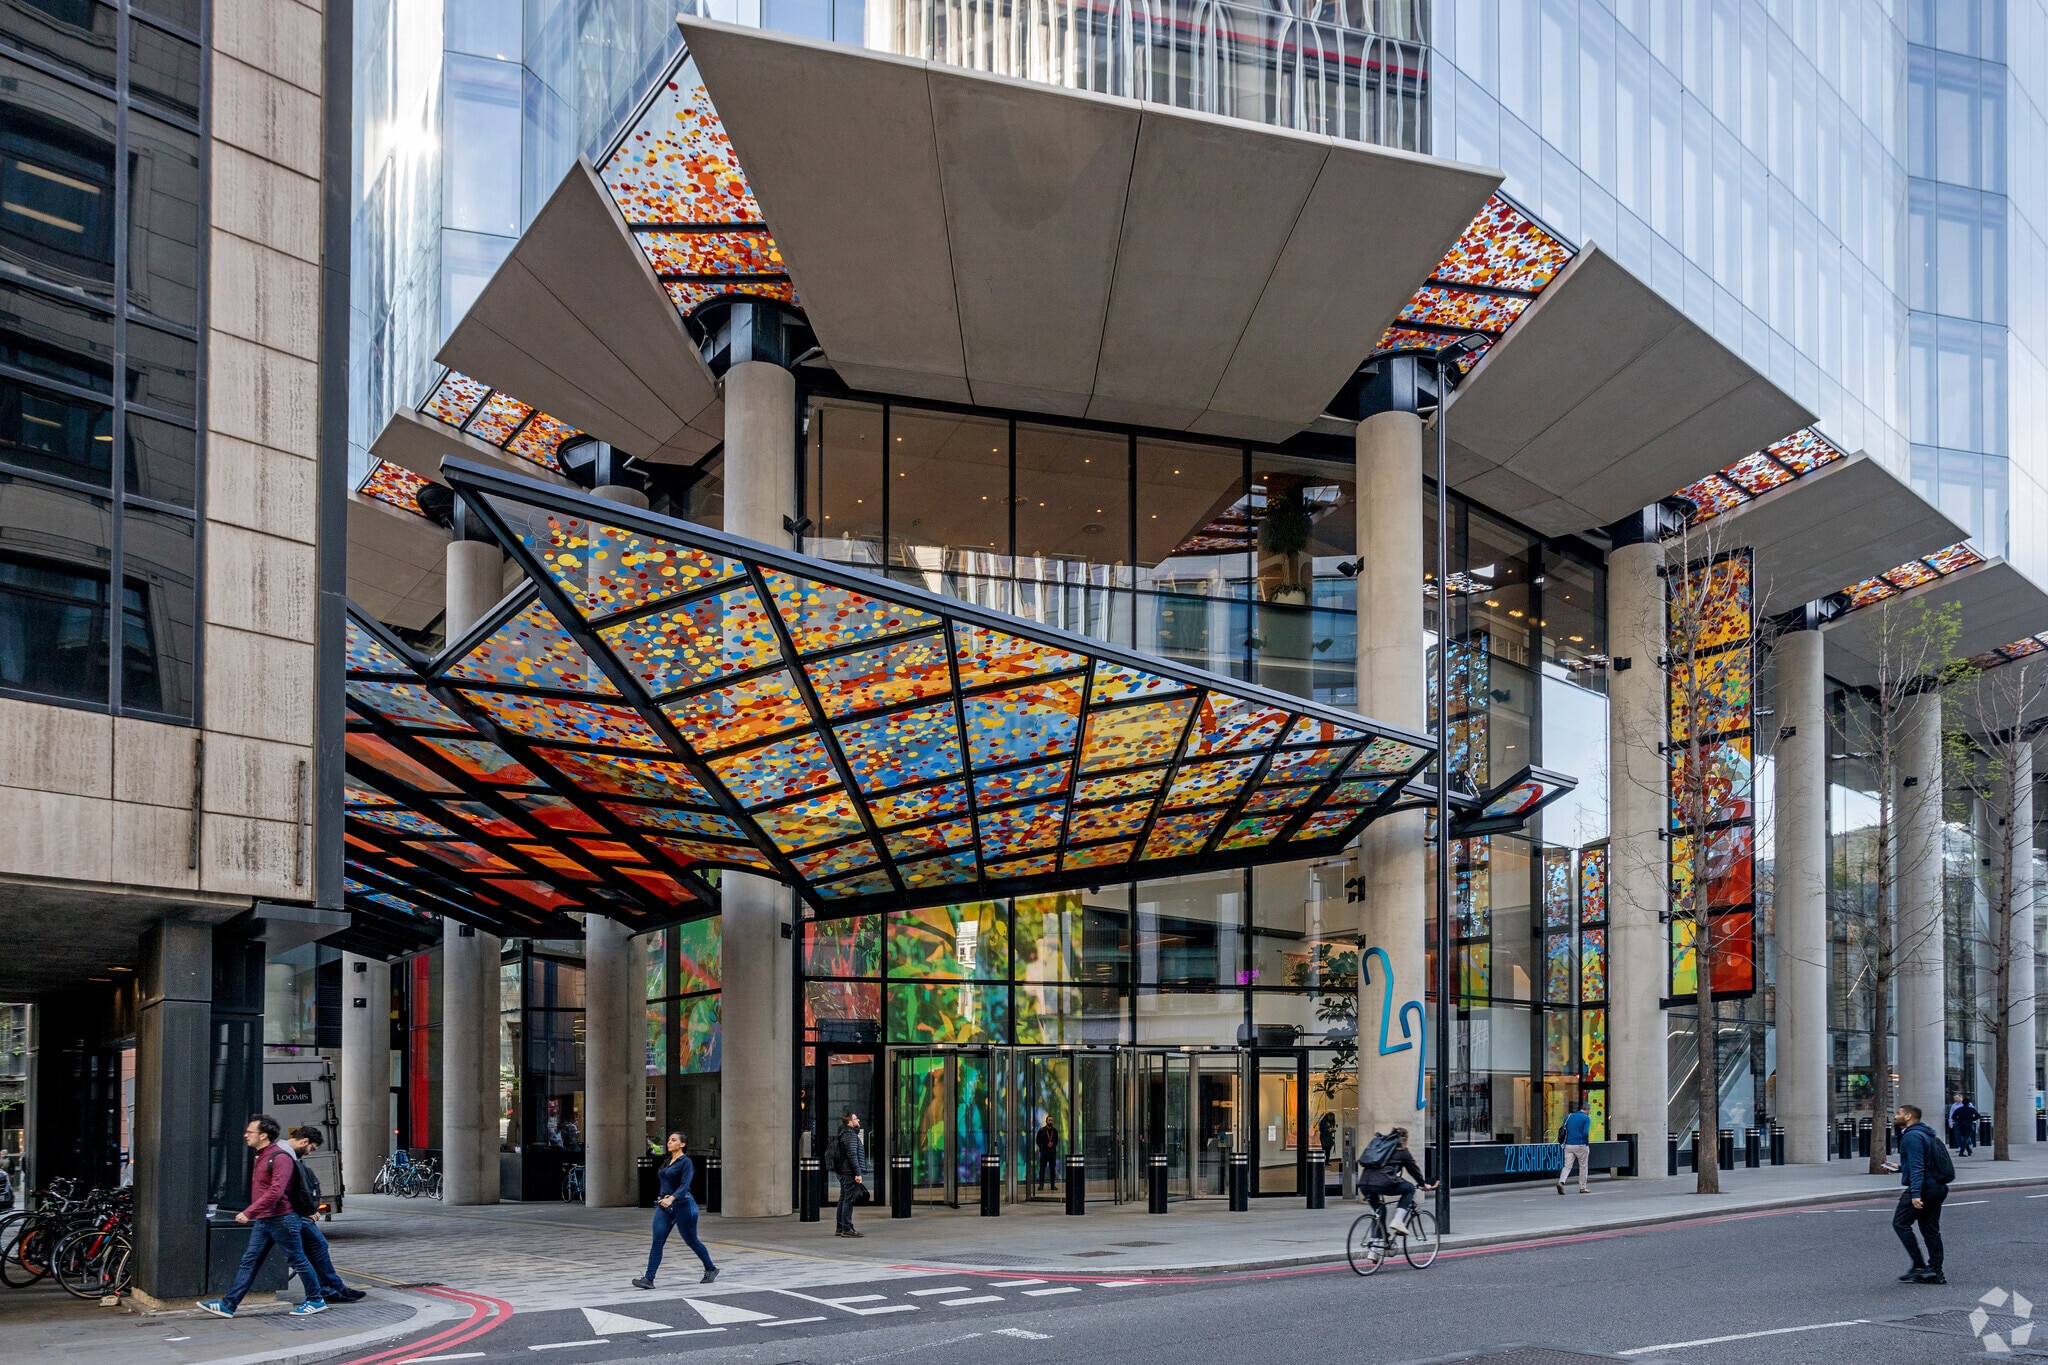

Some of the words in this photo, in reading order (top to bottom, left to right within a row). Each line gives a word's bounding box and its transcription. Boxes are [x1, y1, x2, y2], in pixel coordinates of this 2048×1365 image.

[1362, 946, 1427, 1110] 22
[276, 1093, 309, 1102] LOOMIS
[1504, 1146, 1516, 1173] 22
[1518, 1144, 1564, 1172] BISHOPSGAT
